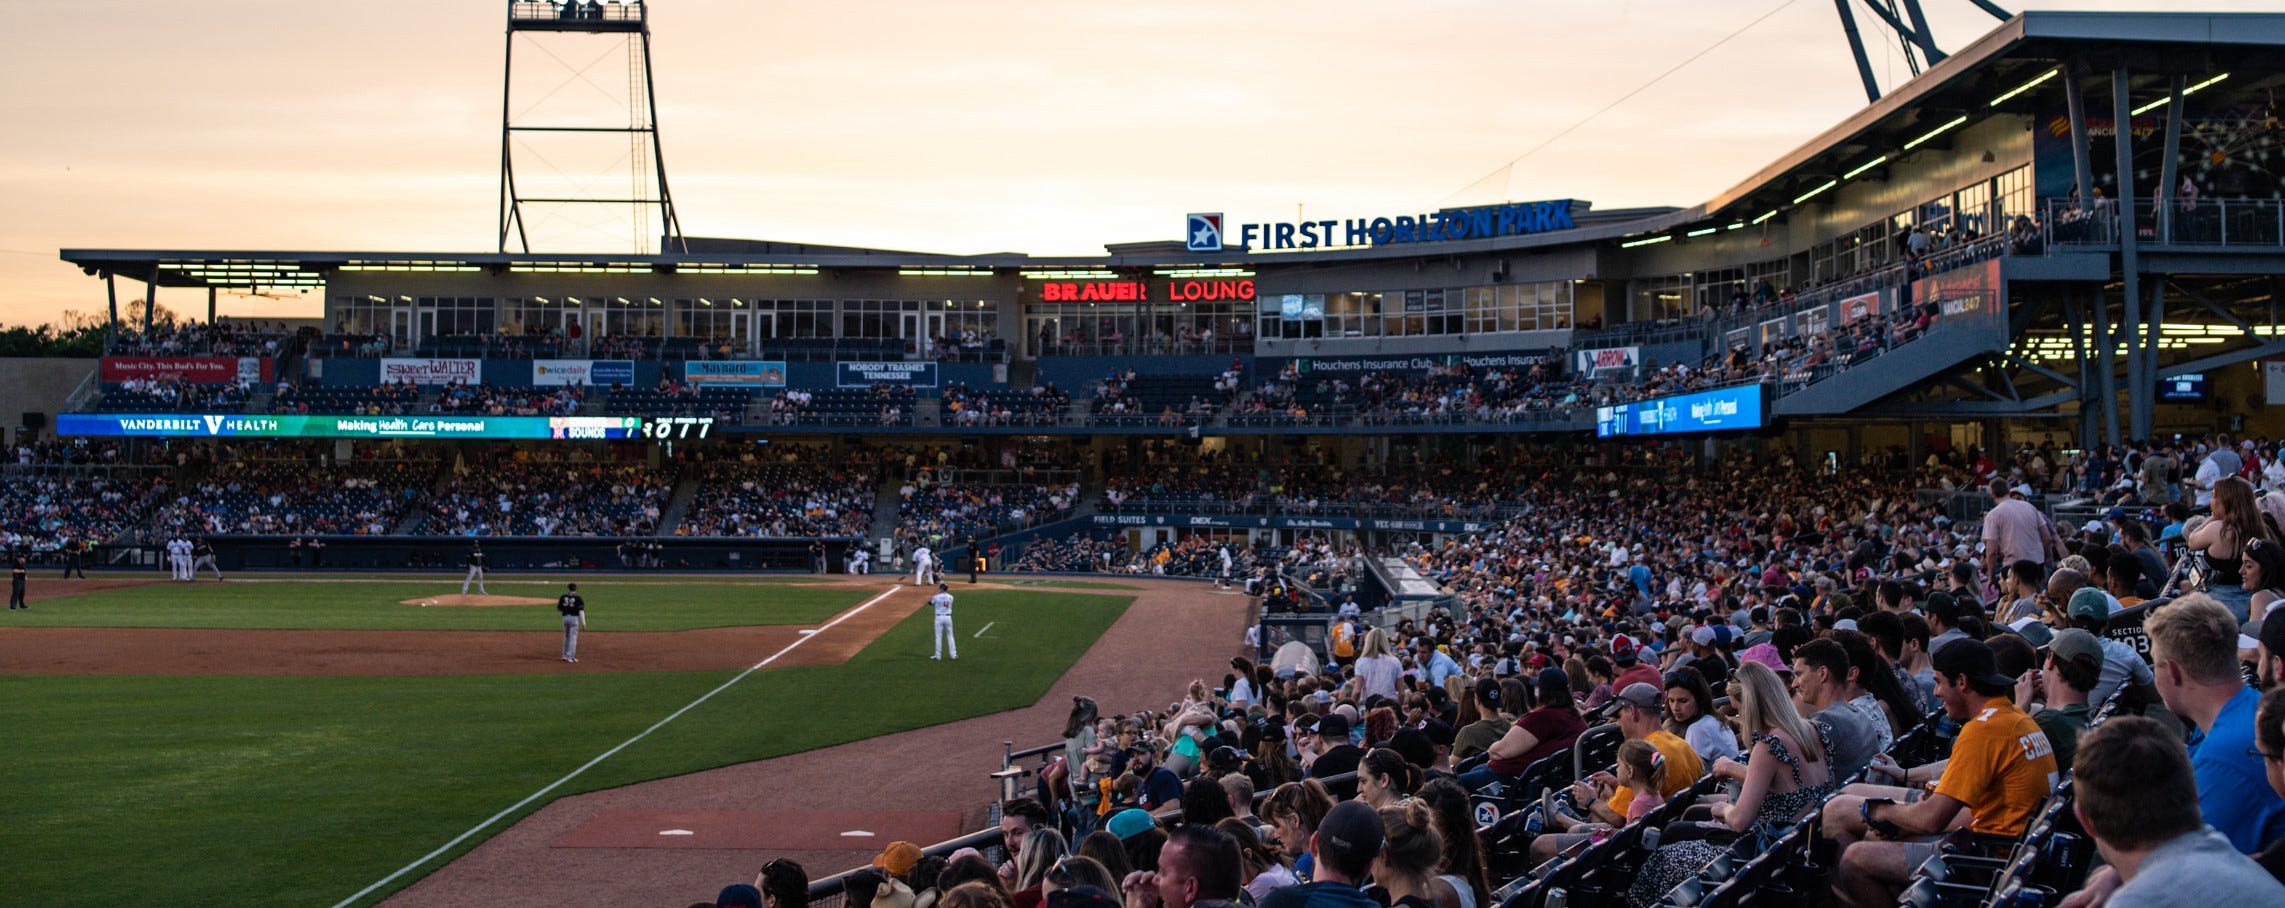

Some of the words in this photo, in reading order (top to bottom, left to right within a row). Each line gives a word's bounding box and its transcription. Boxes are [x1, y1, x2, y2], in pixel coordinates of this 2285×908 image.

[1241, 220, 1338, 251] FIRST
[1346, 208, 1492, 246] HORIZON
[1502, 199, 1574, 235] PARK
[1043, 282, 1147, 301] BRAUER
[1313, 359, 1360, 371] Houchens
[1363, 359, 1409, 370] Insurance
[1411, 358, 1433, 369] Club
[1463, 355, 1506, 367] Houchens
[1508, 354, 1547, 366] Insuranc
[1596, 349, 1626, 368] ARROW
[115, 361, 138, 370] Music
[157, 362, 173, 370] This
[174, 362, 194, 370] Bud's
[195, 362, 208, 370] For
[848, 363, 885, 372] NOBODY
[887, 363, 926, 372] TRASHES
[863, 371, 911, 380] TENNESSEE
[120, 419, 201, 431] VANDERBILT
[203, 415, 225, 435] V
[226, 420, 278, 431] HEALTH
[337, 420, 377, 432] Making
[379, 417, 407, 431] Health
[412, 418, 436, 431] Care
[437, 420, 485, 432] Personal
[625, 417, 635, 427] 0
[568, 427, 607, 439] SOUNDS
[655, 423, 672, 439] 0
[1093, 515, 1115, 524] FIELD
[1117, 516, 1146, 524] SUITES
[1190, 516, 1212, 525] DEX
[2112, 626, 2145, 637] SECTIO
[2113, 635, 2150, 653] 03
